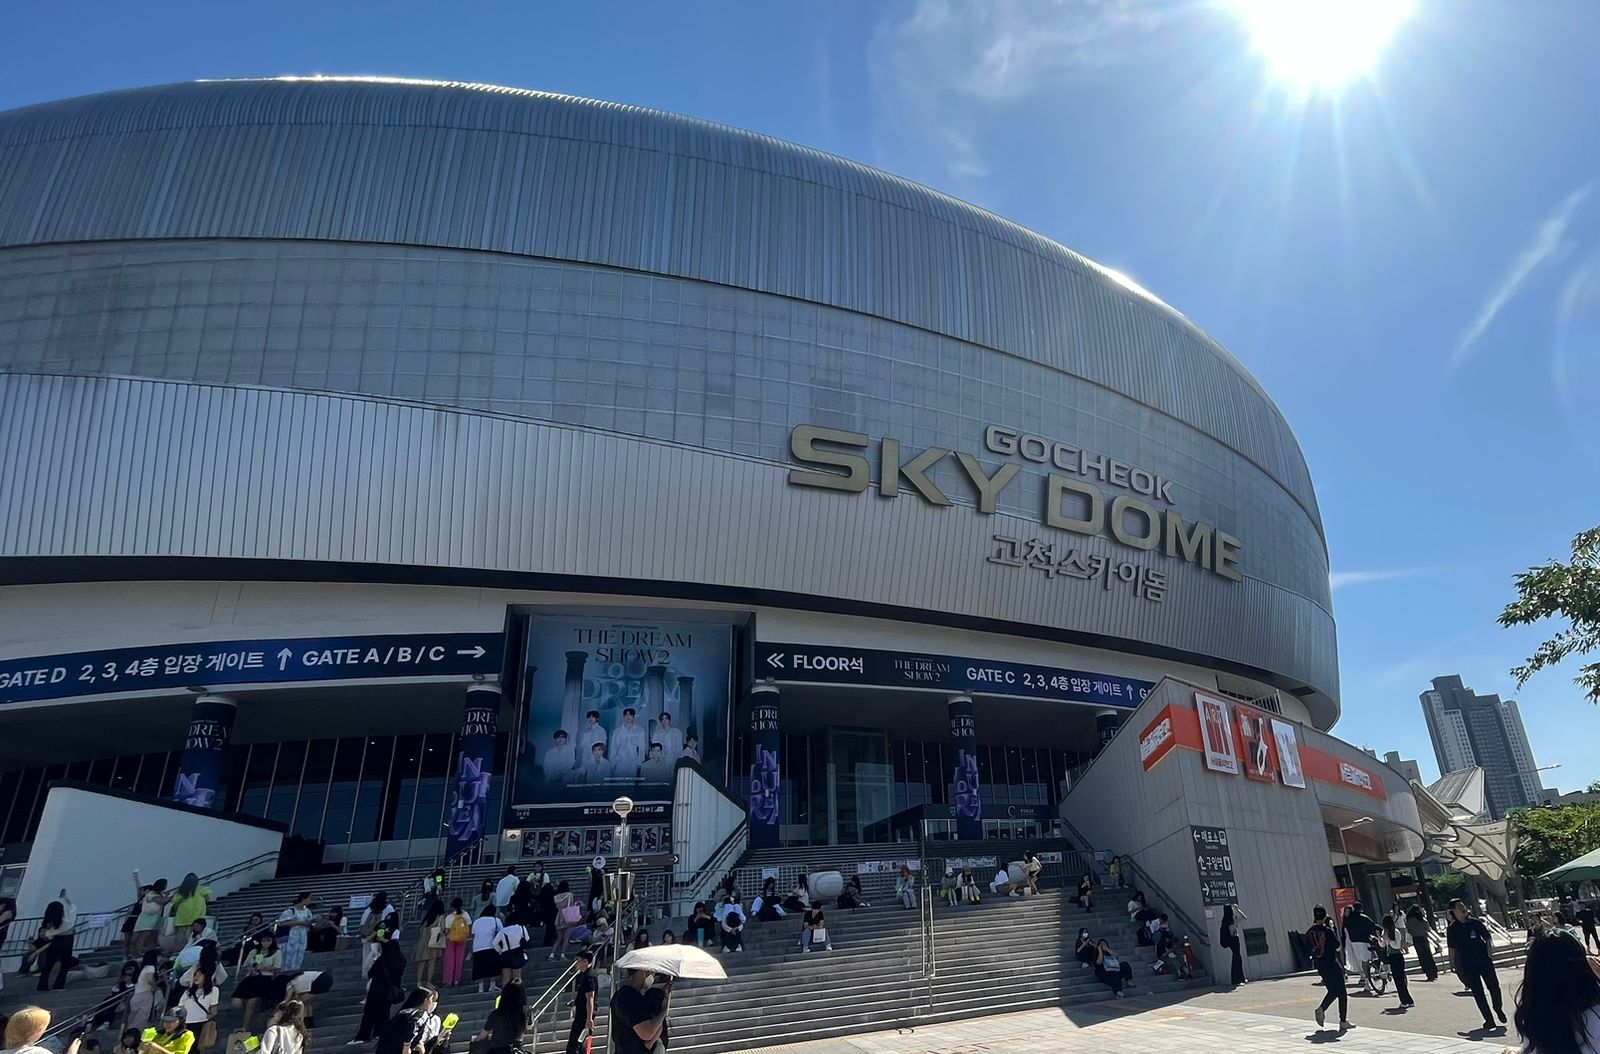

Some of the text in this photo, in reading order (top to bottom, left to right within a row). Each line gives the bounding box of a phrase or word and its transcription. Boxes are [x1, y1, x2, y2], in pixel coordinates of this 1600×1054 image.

[985, 424, 1175, 504] GOCHEOK
[789, 424, 1244, 583] SKY DOME
[987, 534, 1169, 603] 고척스카이돔
[574, 628, 692, 648] THE DREAM
[0, 651, 264, 689] GATE D 2, 3, 4층 입장 게이트
[303, 649, 360, 666] GATE
[793, 654, 864, 674] FLOOR석
[894, 659, 951, 673] THE DREAM
[966, 667, 1122, 698] GATE C 2, 3, 4층 입장 게이트
